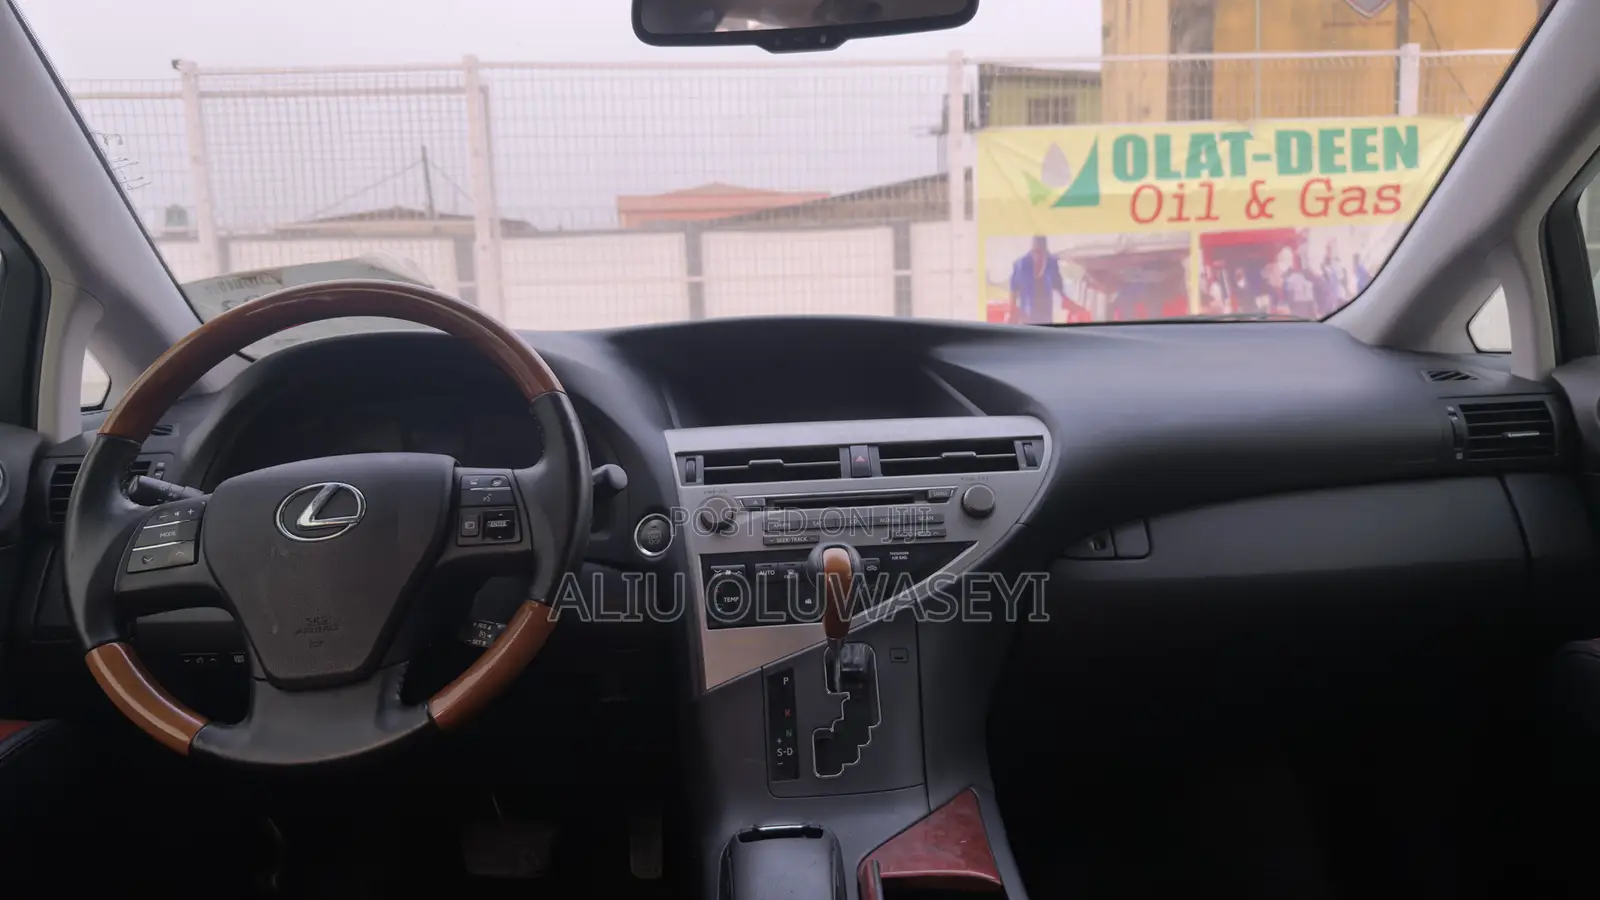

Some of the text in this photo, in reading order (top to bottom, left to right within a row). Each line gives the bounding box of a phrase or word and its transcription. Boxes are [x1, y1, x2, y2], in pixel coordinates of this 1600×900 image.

[1112, 125, 1420, 183] OLAT-DEEN
[1129, 177, 1402, 225] Oil & Gas
[783, 677, 789, 685] P
[784, 709, 791, 717] R
